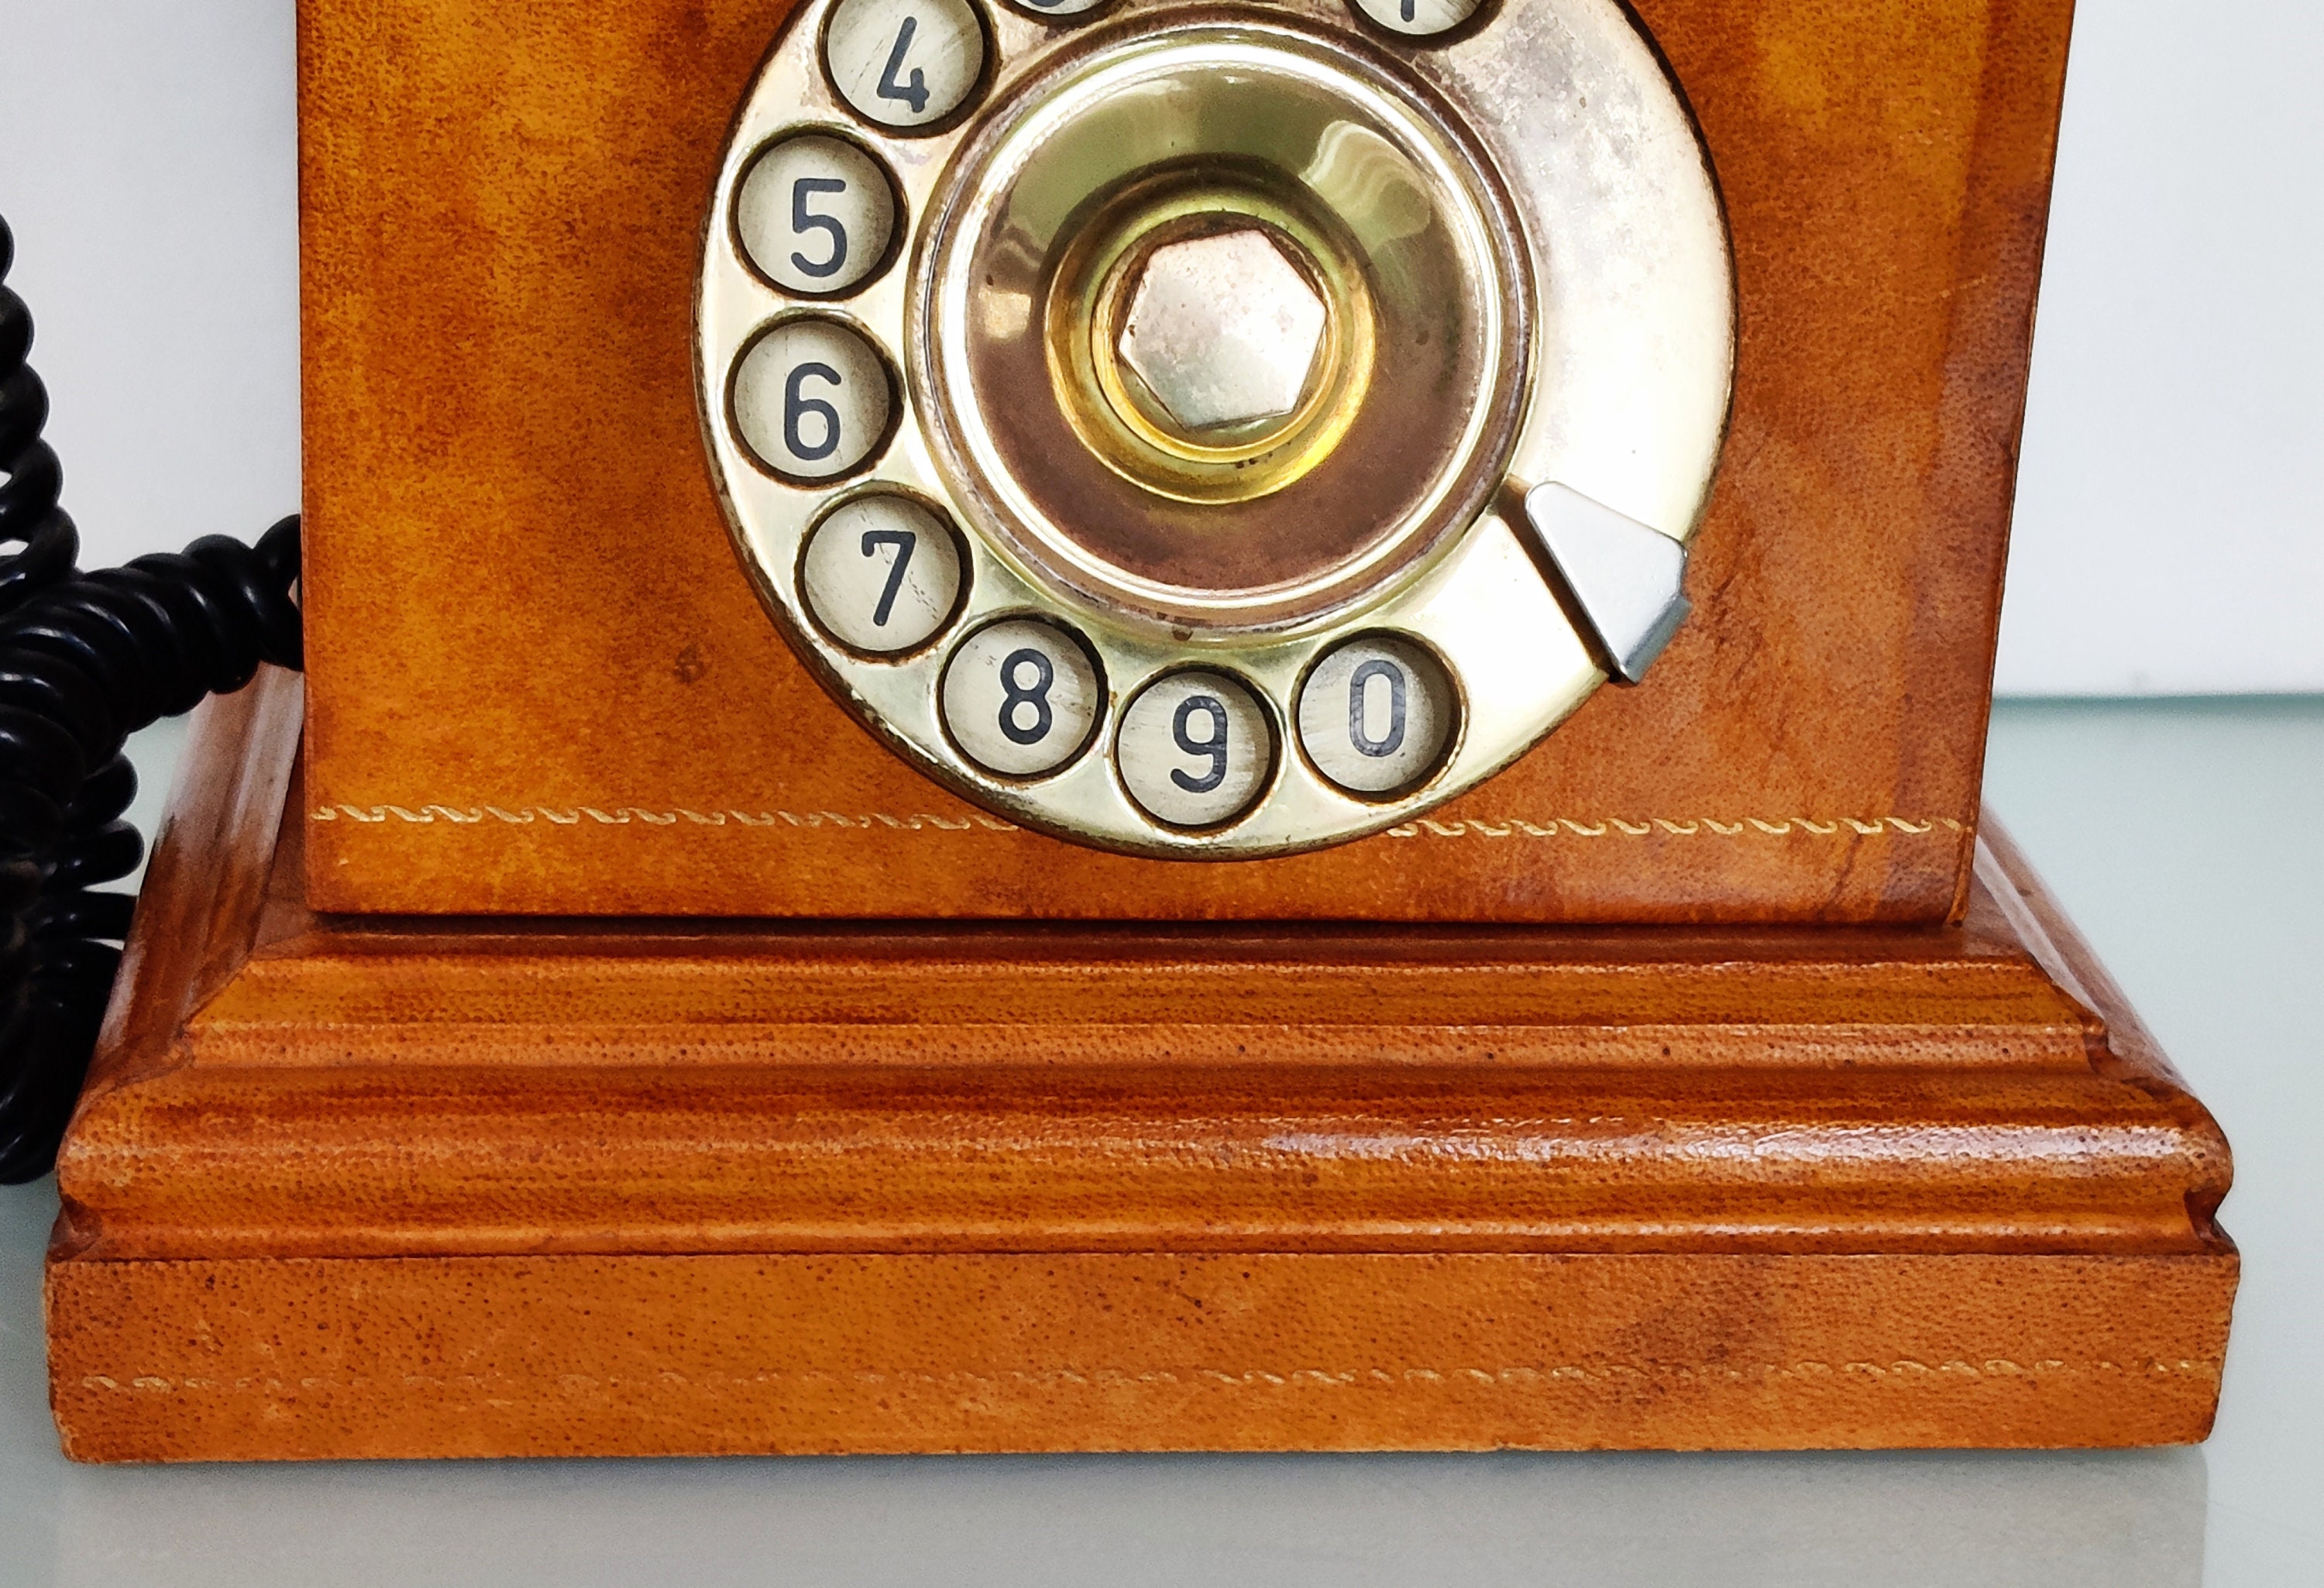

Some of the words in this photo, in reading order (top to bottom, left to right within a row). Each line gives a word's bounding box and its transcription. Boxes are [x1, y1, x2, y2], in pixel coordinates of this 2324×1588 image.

[876, 15, 930, 114] 4
[790, 177, 847, 278] 5
[783, 362, 842, 462] 6
[861, 530, 916, 627] 7
[998, 648, 1054, 745] 8
[1170, 695, 1229, 793] 9
[1349, 659, 1406, 758] 0
